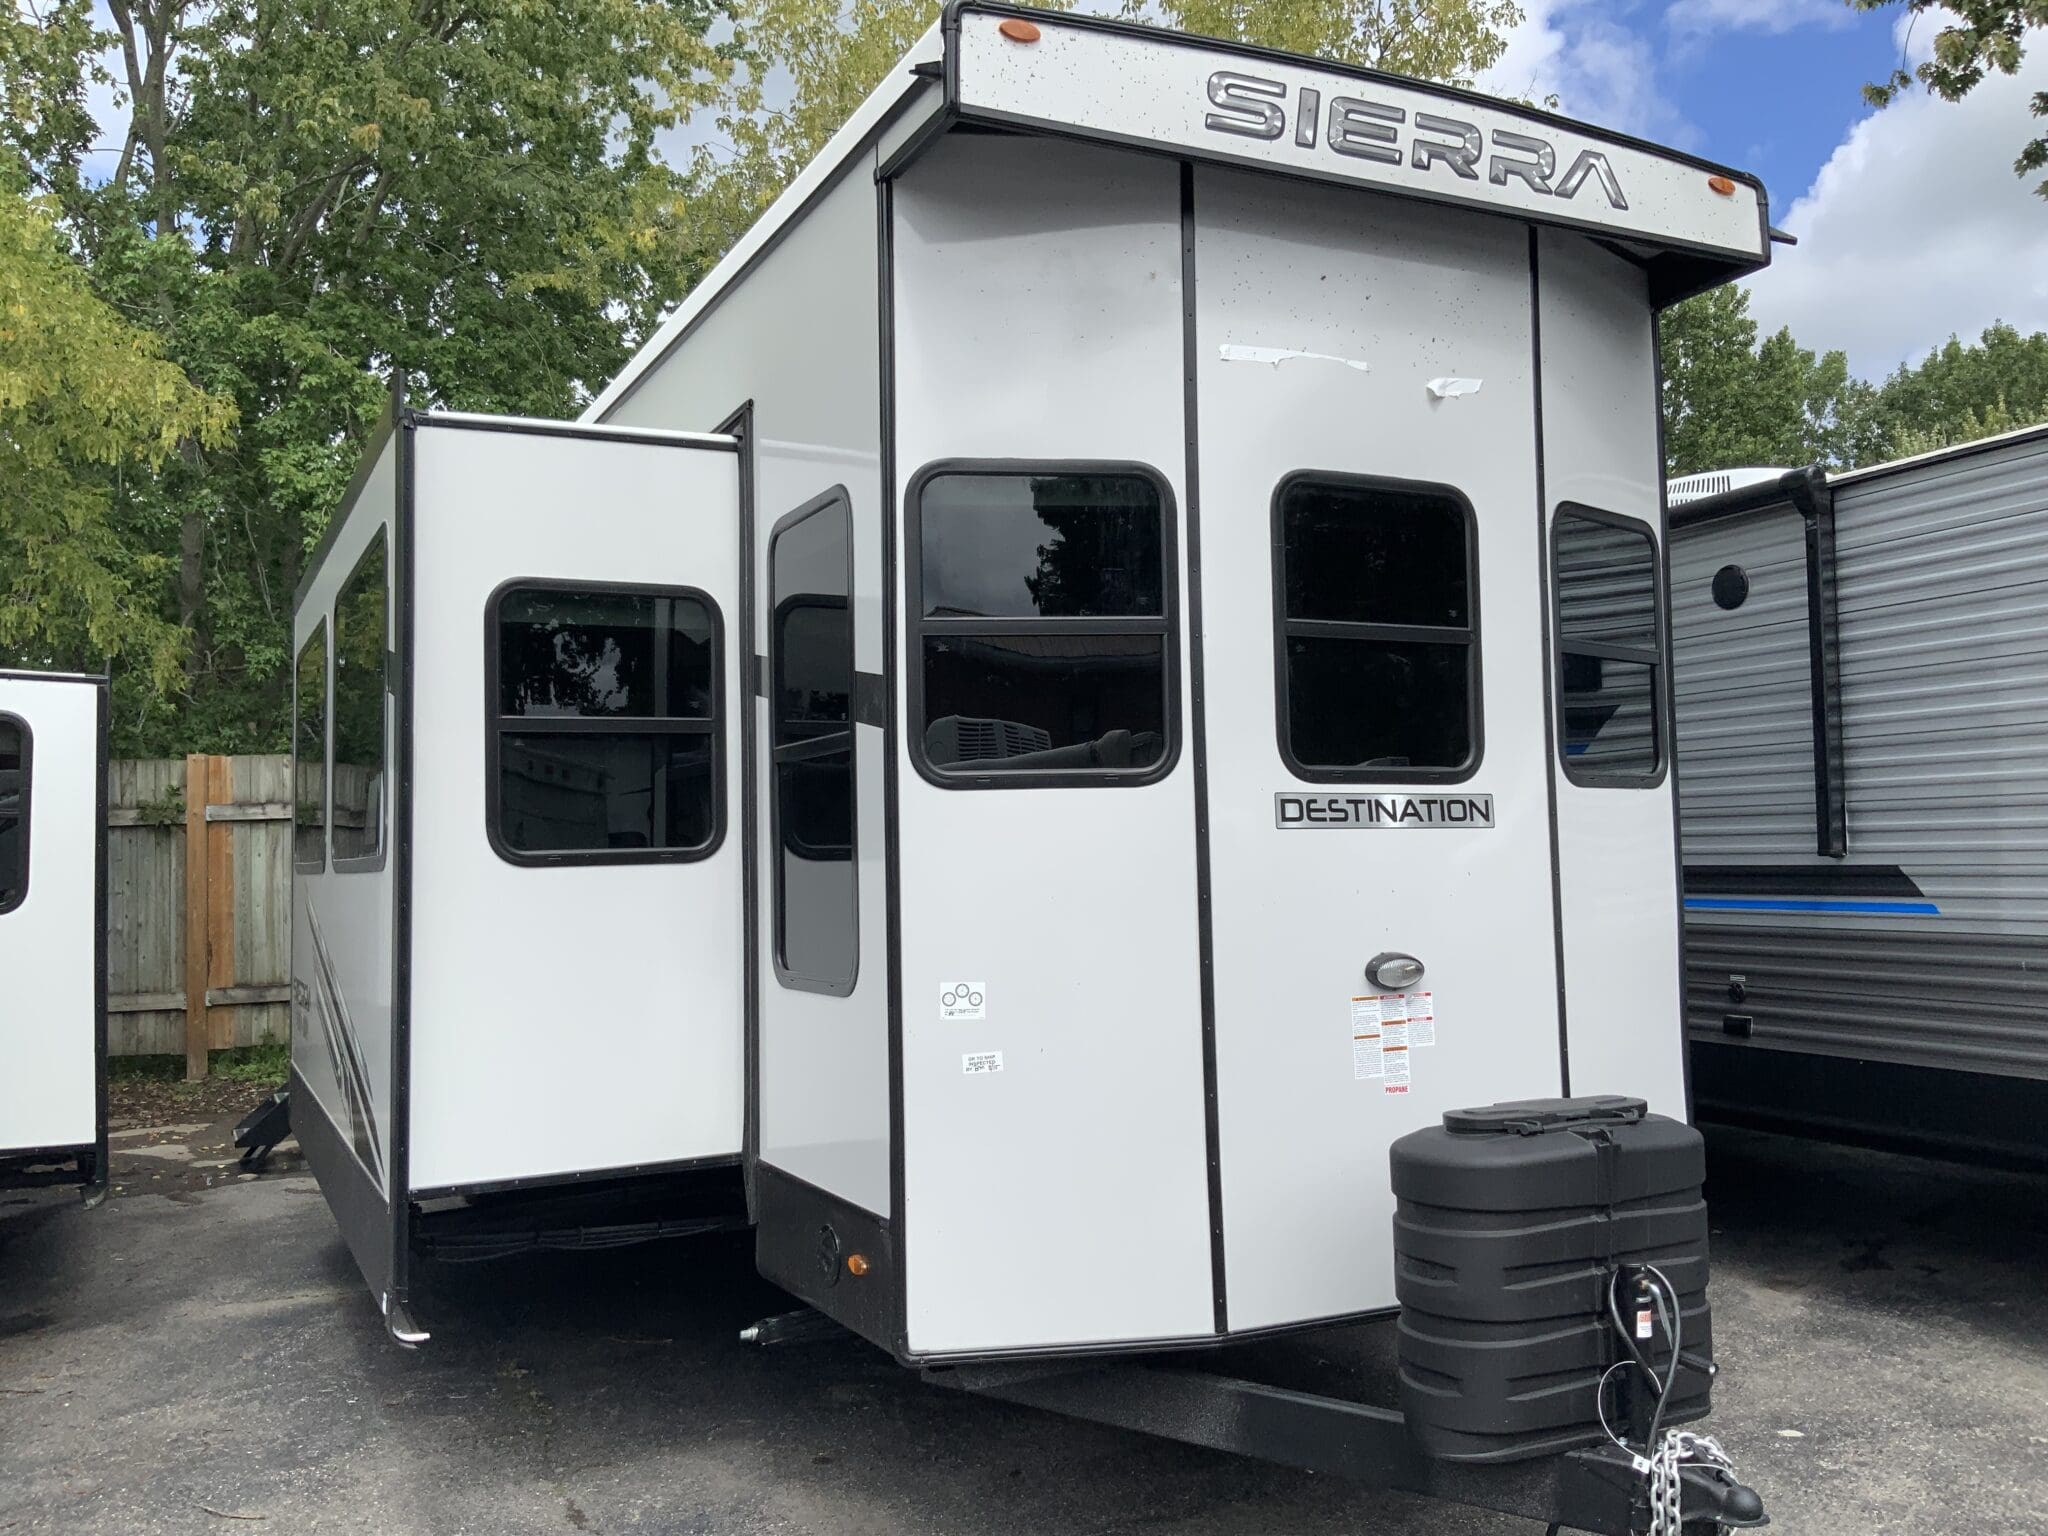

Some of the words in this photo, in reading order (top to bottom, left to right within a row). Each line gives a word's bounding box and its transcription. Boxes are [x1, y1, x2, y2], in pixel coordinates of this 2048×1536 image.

[1205, 70, 1629, 210] SIERRA
[1280, 798, 1490, 823] DESTINATION
[1385, 1085, 1408, 1094] PROPANE
